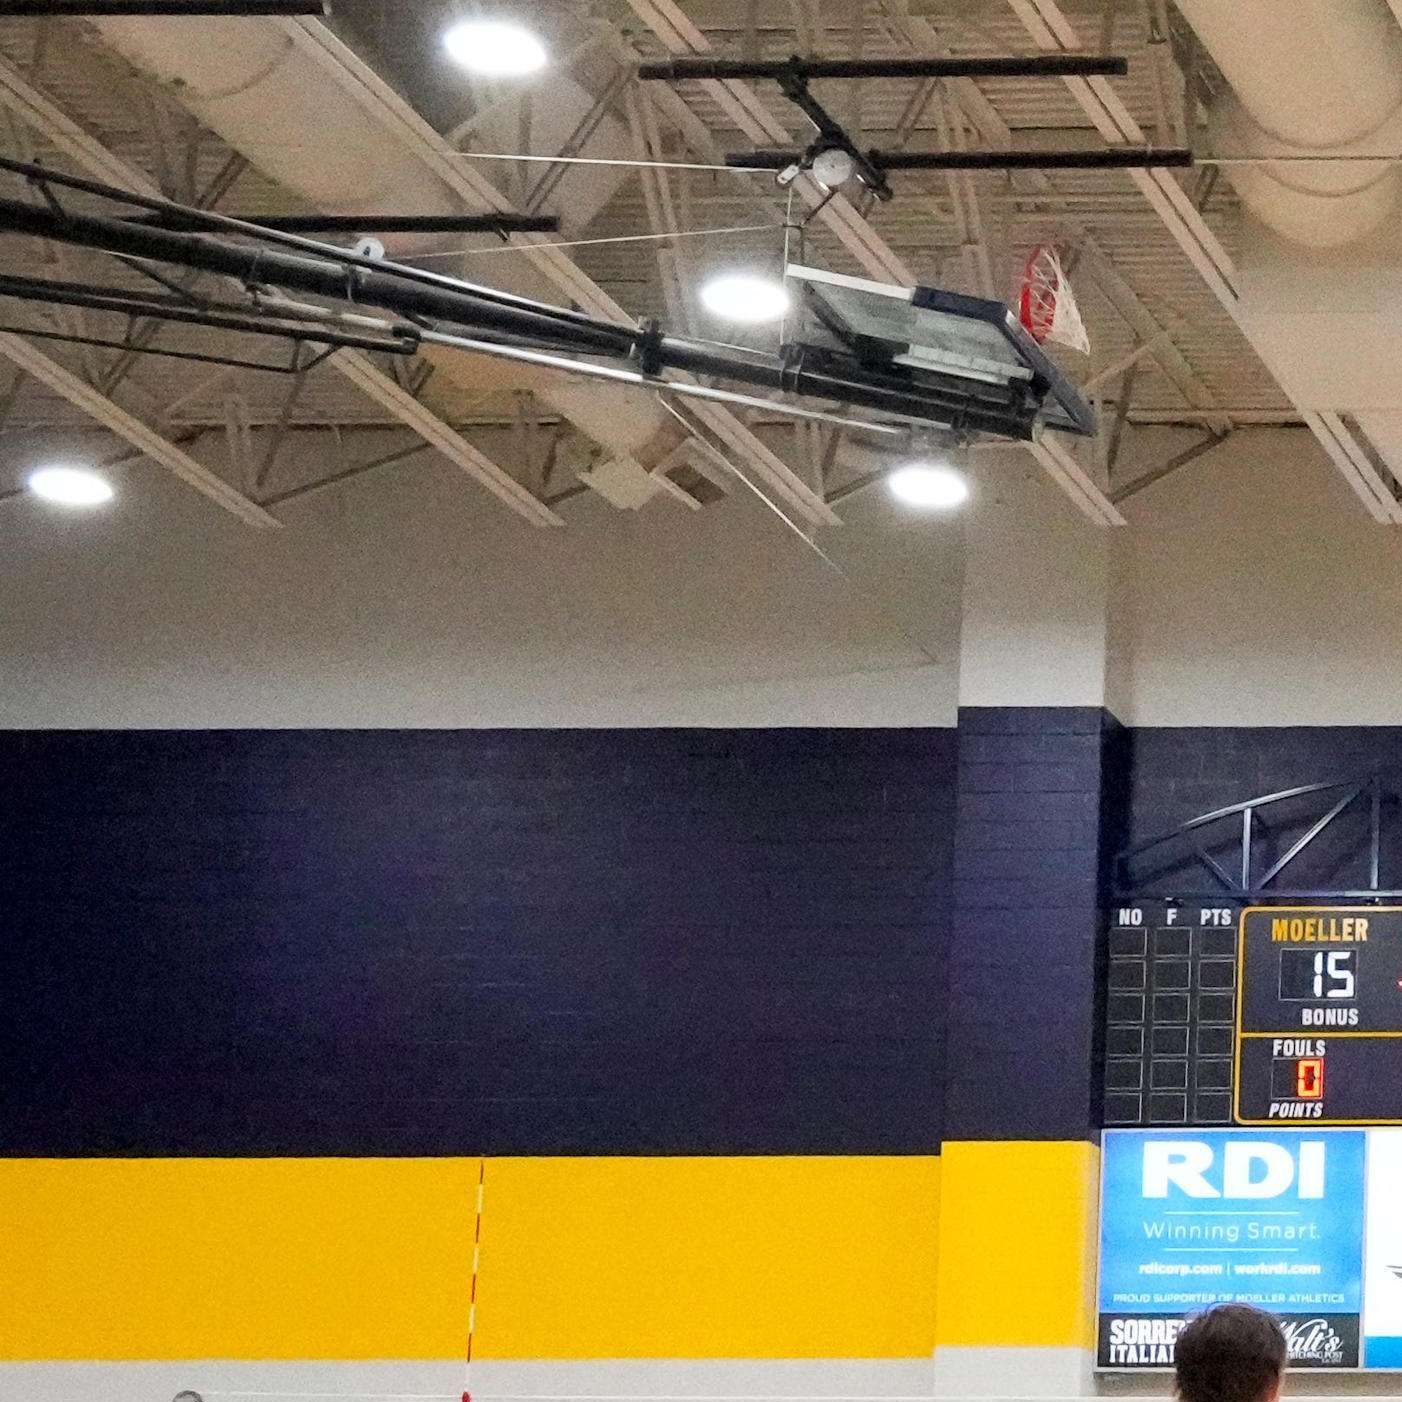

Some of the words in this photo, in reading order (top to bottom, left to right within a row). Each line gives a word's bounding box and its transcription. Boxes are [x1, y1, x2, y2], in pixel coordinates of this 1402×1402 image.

[1119, 909, 1142, 926] NO
[1167, 909, 1176, 926] F
[1201, 909, 1231, 926] PTS
[1272, 917, 1368, 942] MOELLER
[1313, 951, 1354, 998] 15
[1302, 1008, 1359, 1026] BONUS
[1273, 1039, 1326, 1056] FOULS
[1297, 1059, 1322, 1099] 0
[1269, 1102, 1323, 1118] POINTS
[1142, 1141, 1325, 1199] RDI
[1143, 1222, 1240, 1242] Winning
[1248, 1222, 1321, 1240] Smart.
[1139, 1262, 1223, 1277] rdicorp.com
[1235, 1262, 1321, 1275] workrdi.com
[1113, 1294, 1150, 1303] PROUD
[1153, 1294, 1215, 1303] SUPPORTER
[1218, 1294, 1234, 1303] OF
[1236, 1294, 1286, 1303] MOELLER
[1287, 1293, 1345, 1303] ATHLETICS
